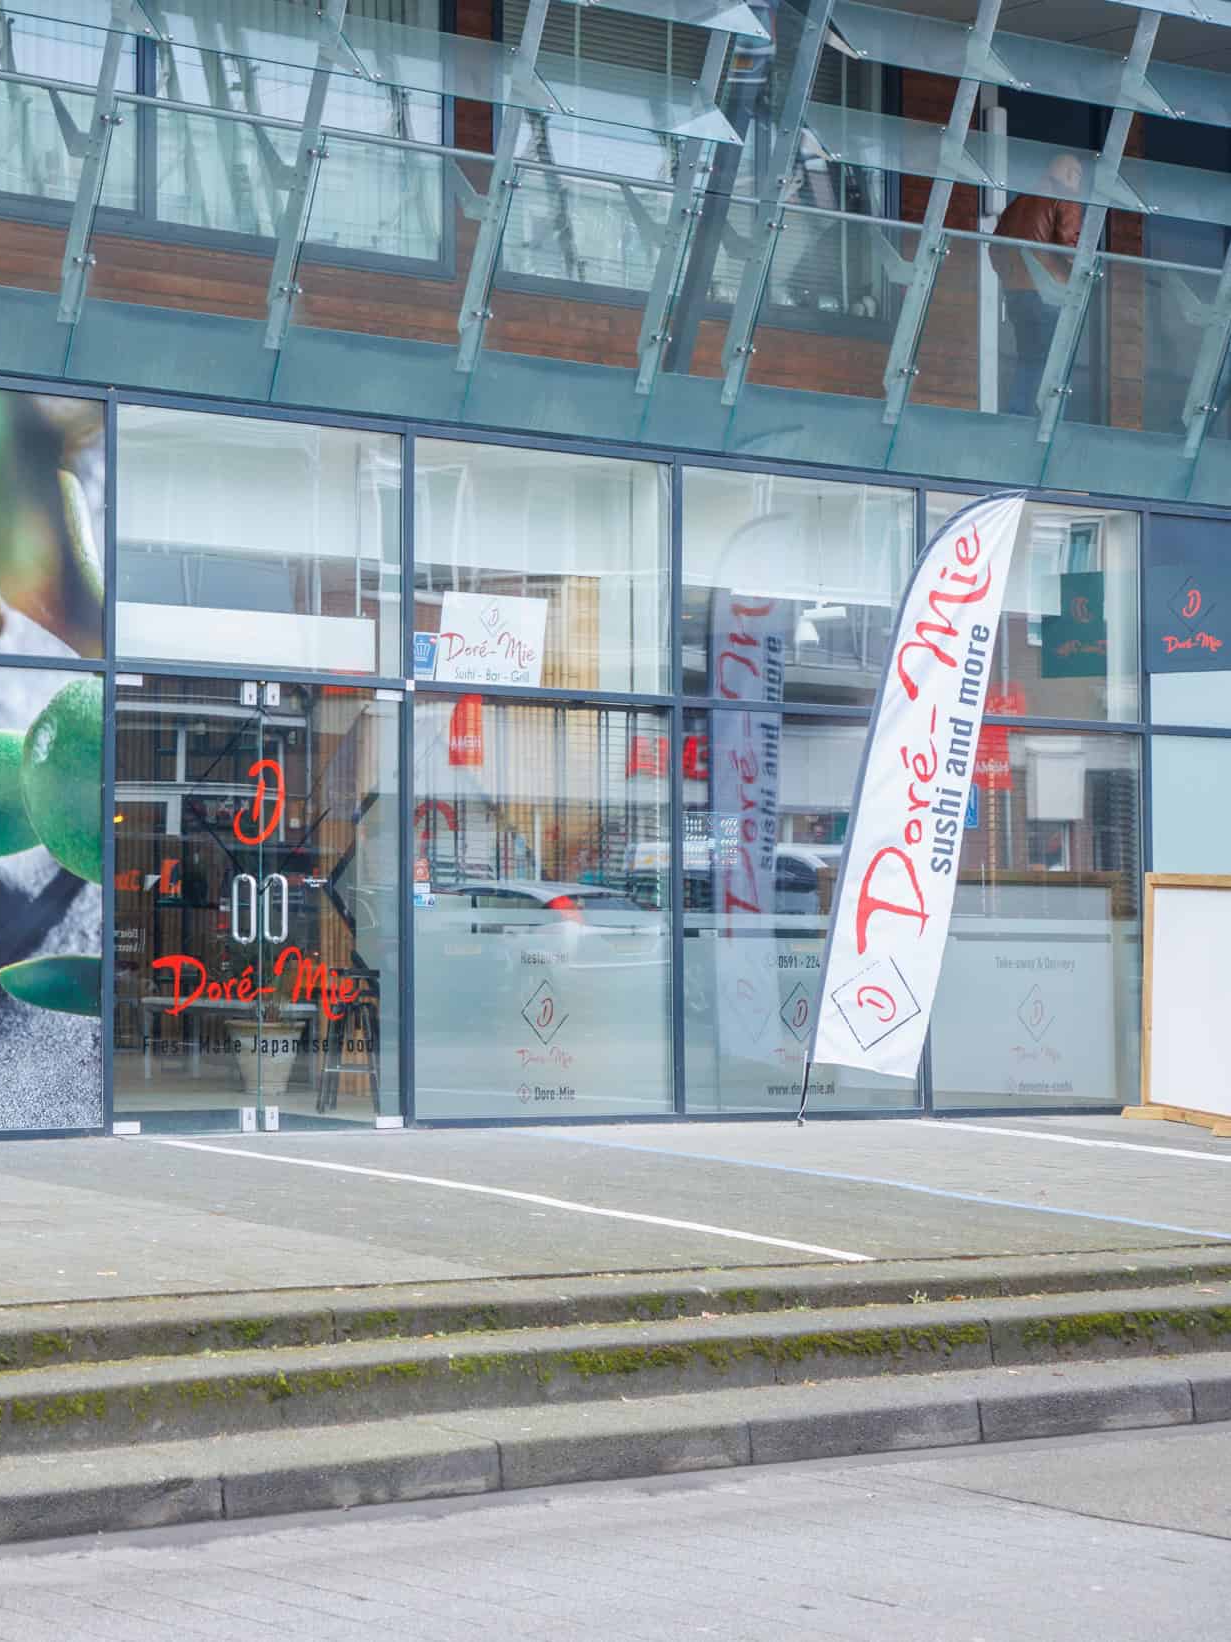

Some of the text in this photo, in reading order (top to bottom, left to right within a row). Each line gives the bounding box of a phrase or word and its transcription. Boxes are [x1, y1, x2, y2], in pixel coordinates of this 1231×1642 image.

[931, 624, 991, 876] sushi and more
[778, 956, 798, 969] 0591
[152, 946, 362, 1021] Doré-Mie
[144, 1035, 191, 1053] Fres
[767, 1082, 835, 1096] www.domie.nl
